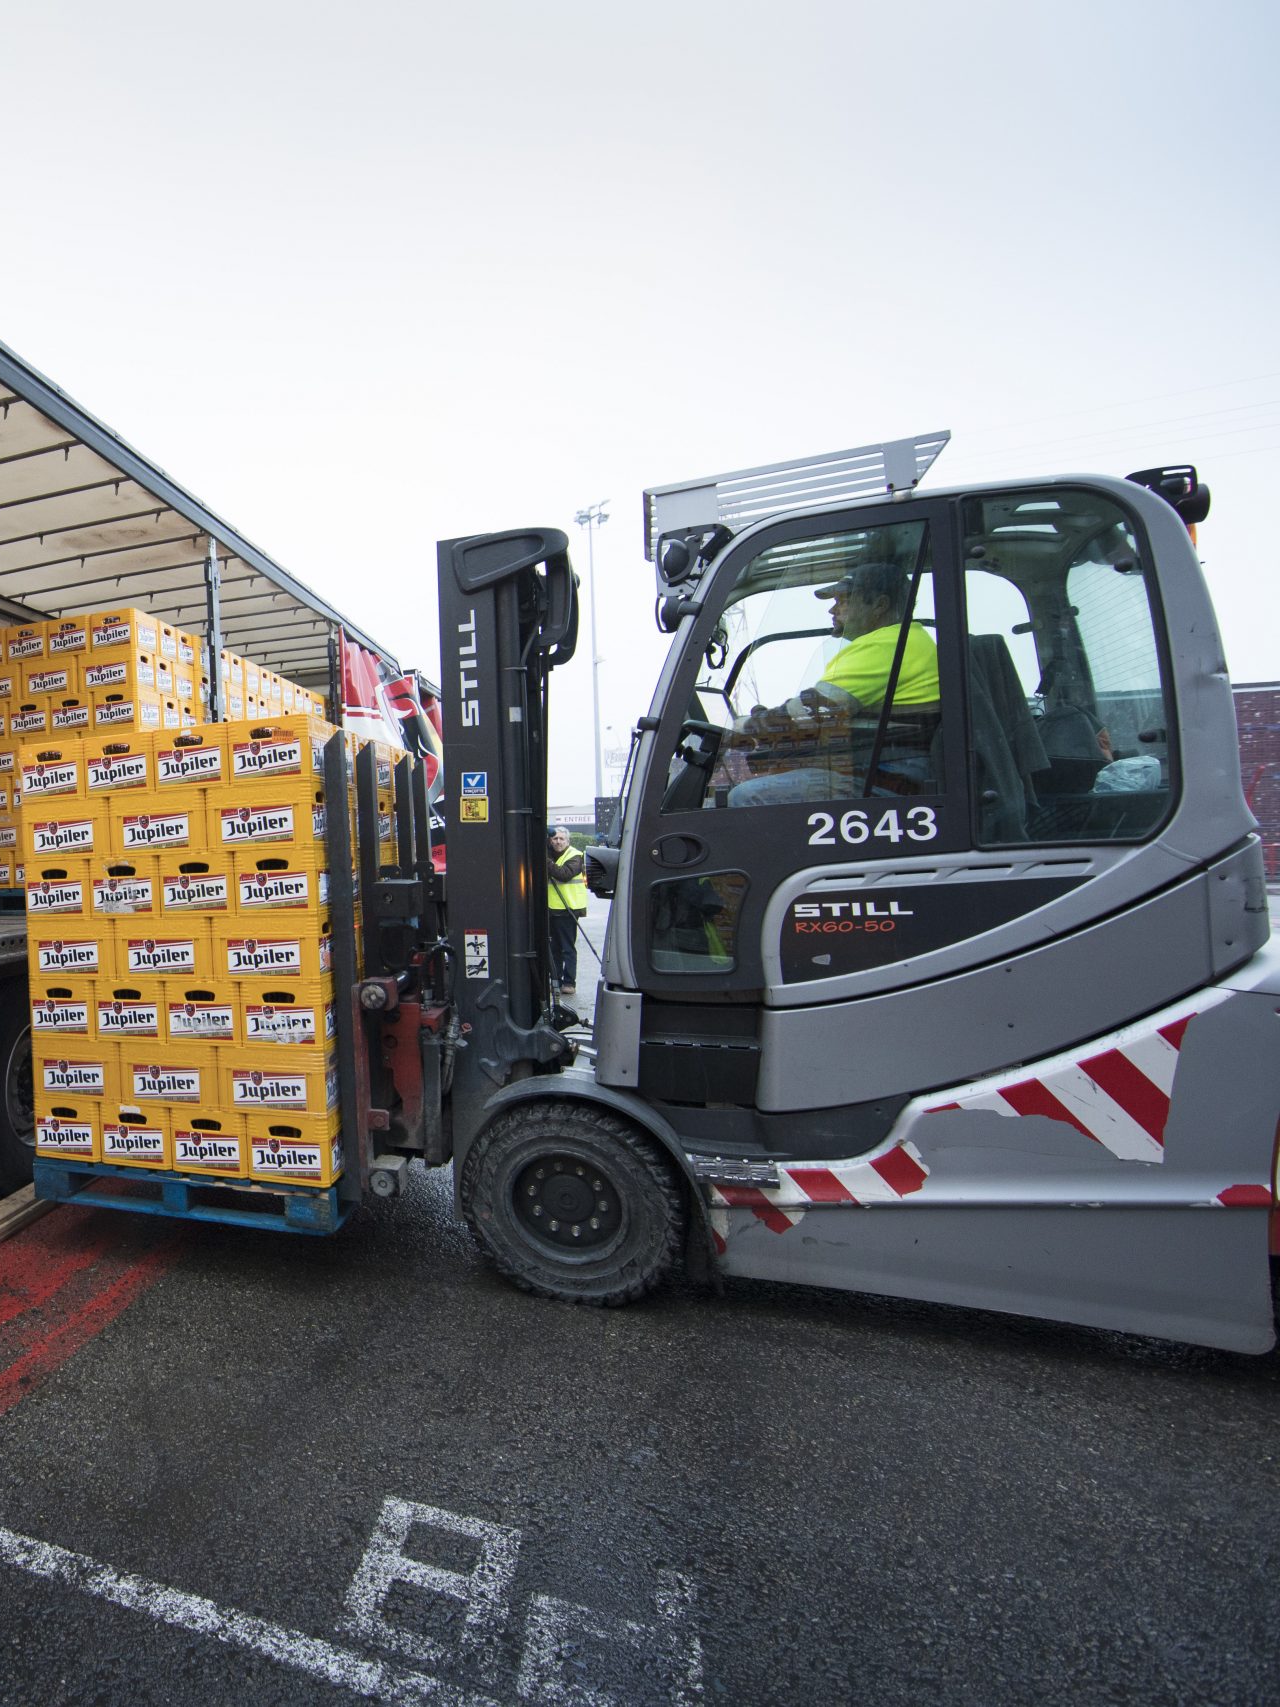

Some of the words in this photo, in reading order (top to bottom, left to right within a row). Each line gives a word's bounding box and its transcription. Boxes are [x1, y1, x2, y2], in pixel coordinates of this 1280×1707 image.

[52, 634, 83, 647] Jupiler
[96, 627, 128, 642] Jupiler
[10, 640, 41, 655] Jupiler
[89, 668, 123, 683] Jupiler
[458, 609, 480, 727] STILL
[33, 677, 65, 690] Jupiler
[56, 710, 86, 724] Jupiler
[99, 703, 131, 719] Jupiler
[14, 717, 43, 728] Jupiler
[163, 755, 217, 776] Jupiler
[238, 746, 296, 769] Jupiler
[92, 761, 143, 782] Jupiler
[27, 772, 74, 790] Jupiler
[128, 821, 183, 842] Jupiler
[226, 813, 288, 838] Jupiler
[807, 806, 938, 846] 2643
[39, 828, 88, 850] Jupiler
[32, 888, 79, 906] Jupiler
[97, 886, 149, 903] Jupiler
[169, 884, 223, 903] Jupiler
[244, 882, 303, 900] Jupiler
[794, 901, 914, 918] STILL
[795, 920, 896, 934] RX60-50
[44, 950, 94, 968] Jupiler
[134, 949, 189, 968] Jupiler
[234, 948, 294, 968] Jupiler
[37, 1010, 84, 1028] Jupiler
[102, 1011, 154, 1029] Jupiler
[48, 1069, 99, 1087] Jupiler
[138, 1076, 194, 1094] Jupiler
[239, 1082, 300, 1102] Jupiler
[41, 1130, 89, 1146] Jupiler
[109, 1136, 160, 1151] Jupiler
[180, 1142, 235, 1159] Jupiler
[257, 1149, 316, 1168] Jupiler
